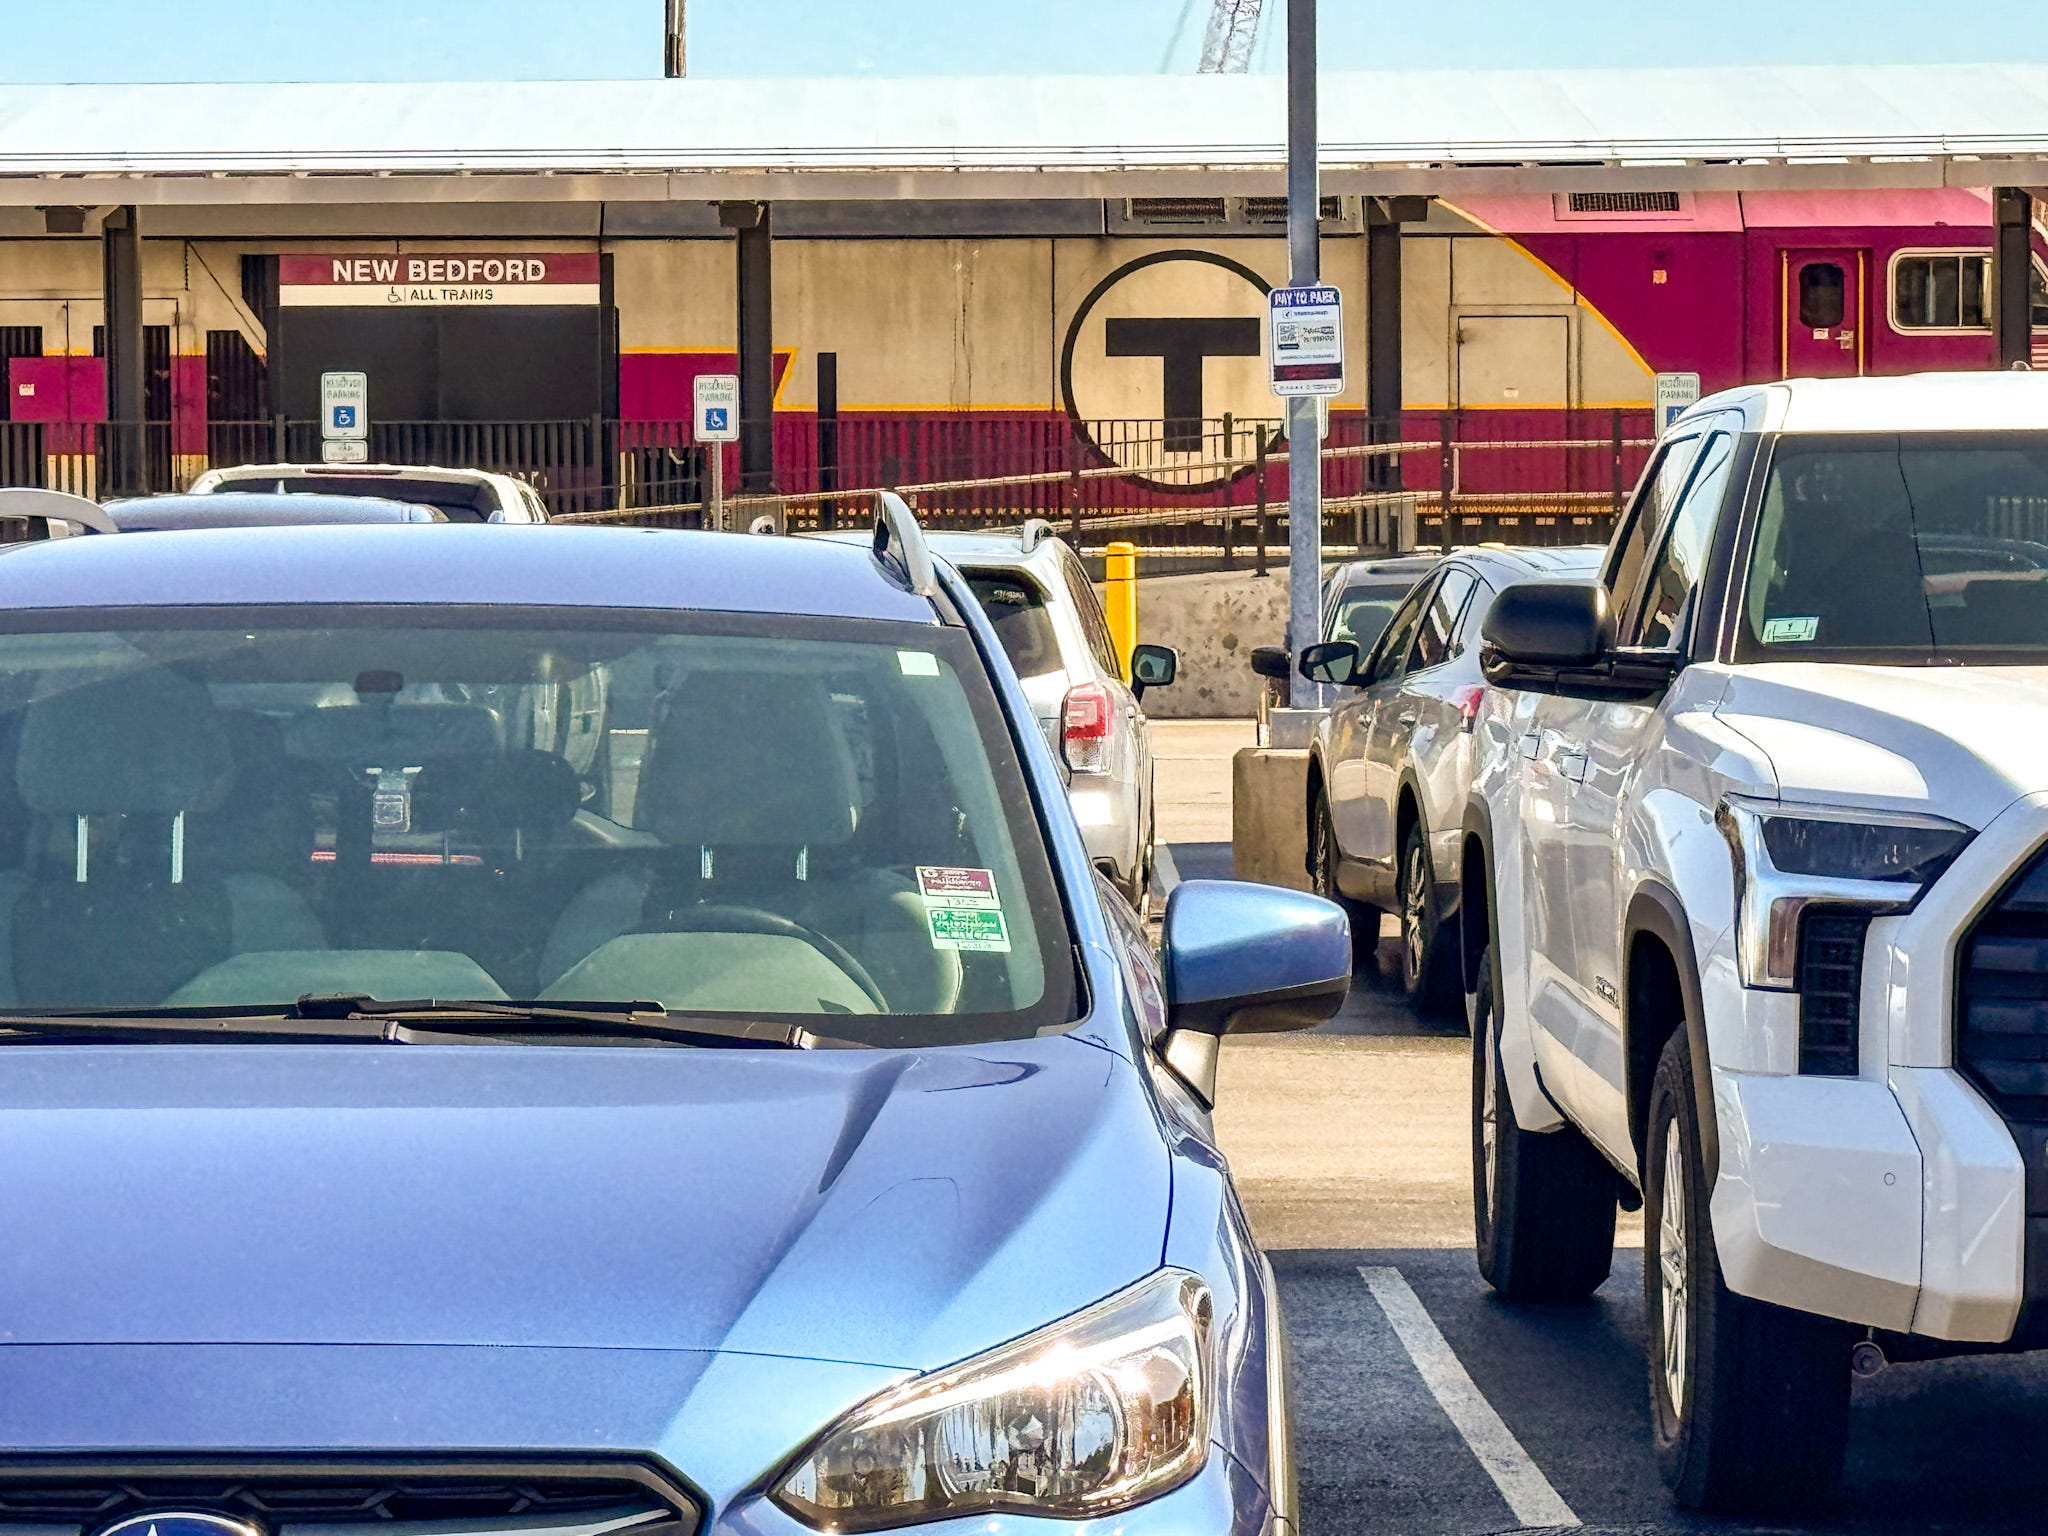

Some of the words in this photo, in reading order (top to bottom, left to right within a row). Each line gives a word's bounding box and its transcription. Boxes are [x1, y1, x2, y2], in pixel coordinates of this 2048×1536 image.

[332, 259, 398, 282] NEW
[408, 259, 546, 282] BEDFORD
[410, 289, 437, 300] ALL
[440, 288, 493, 300] TRAINS
[1274, 291, 1292, 306] PAY
[1294, 290, 1307, 305] TO
[1310, 290, 1336, 304] PARK
[1105, 317, 1261, 452] T
